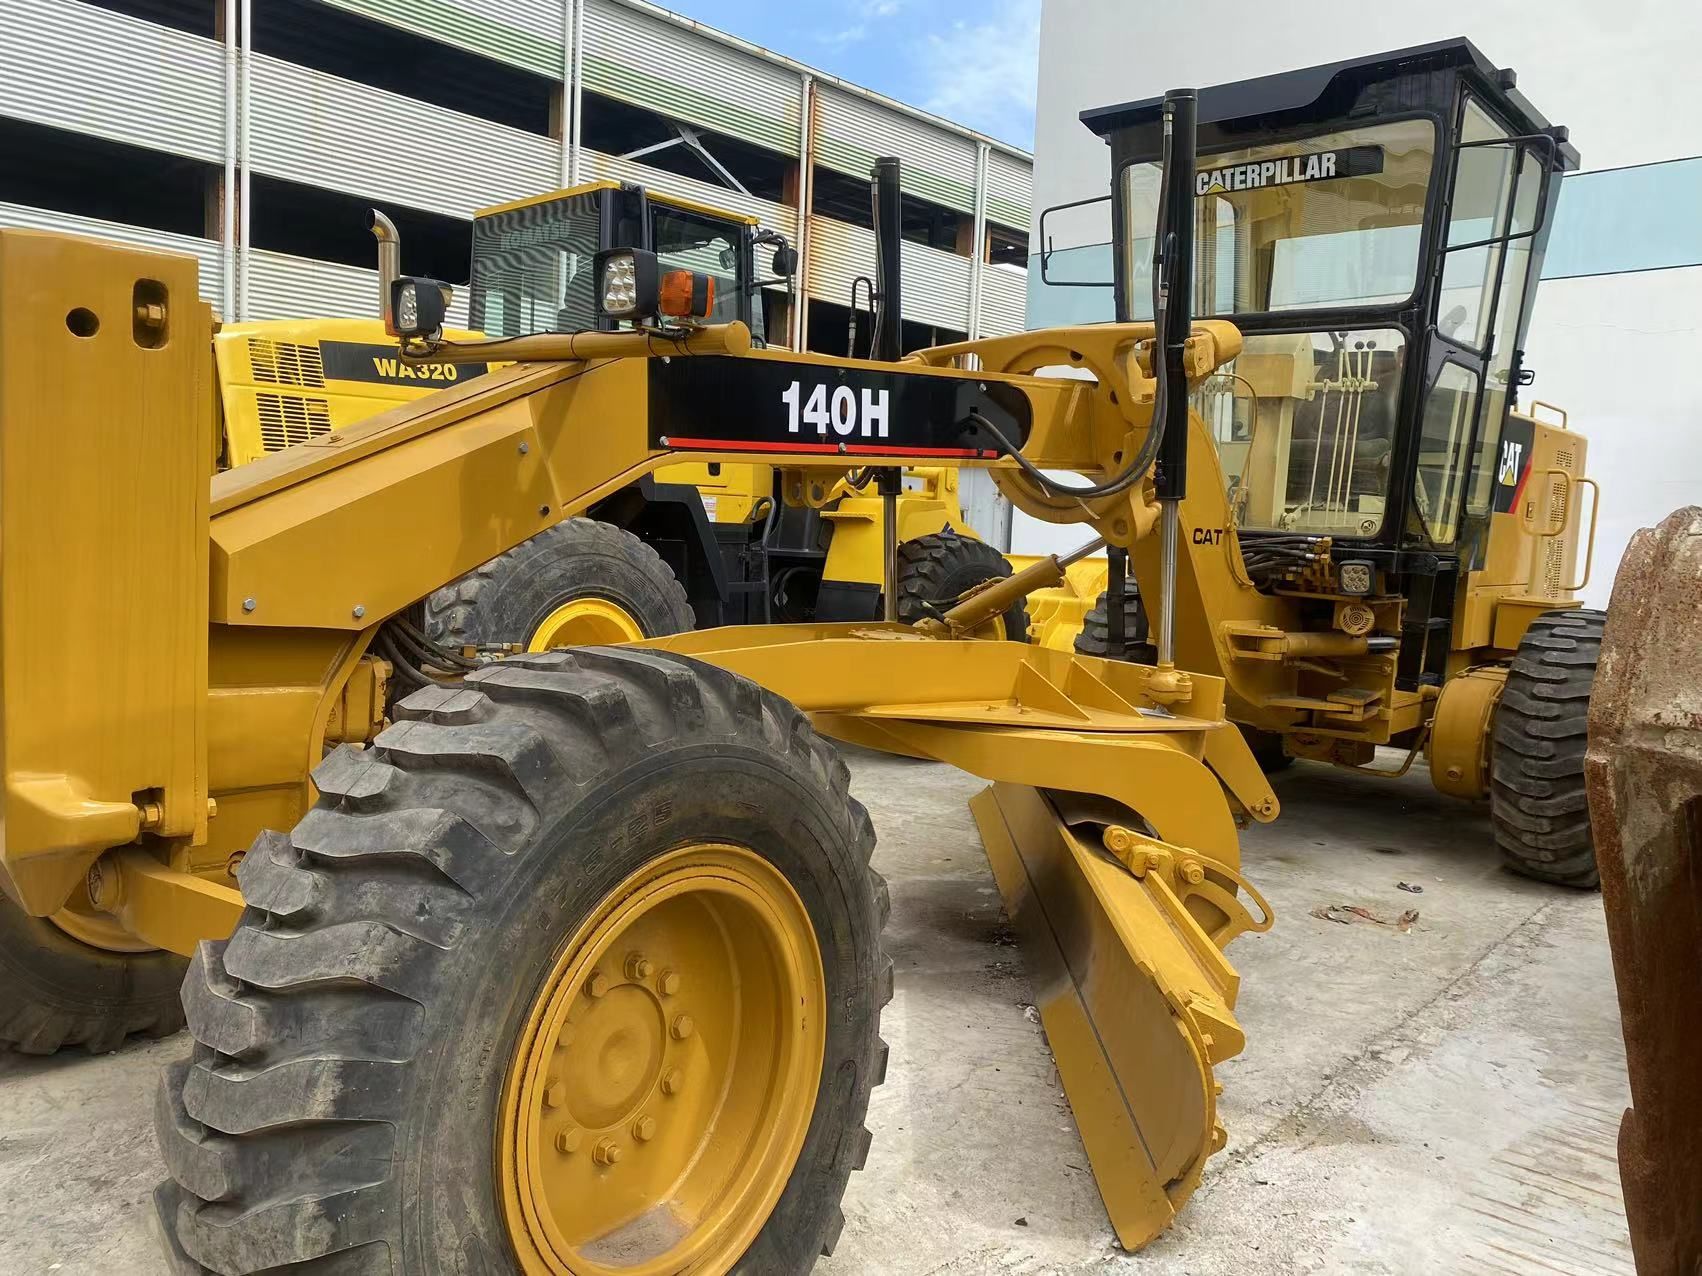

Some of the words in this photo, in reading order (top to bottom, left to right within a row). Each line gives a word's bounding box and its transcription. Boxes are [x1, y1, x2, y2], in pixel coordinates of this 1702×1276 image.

[1196, 152, 1336, 195] CATERPILLAR
[372, 357, 458, 381] WA320
[782, 380, 890, 438] 140H
[1498, 439, 1523, 487] CAT
[1192, 527, 1223, 546] CAT
